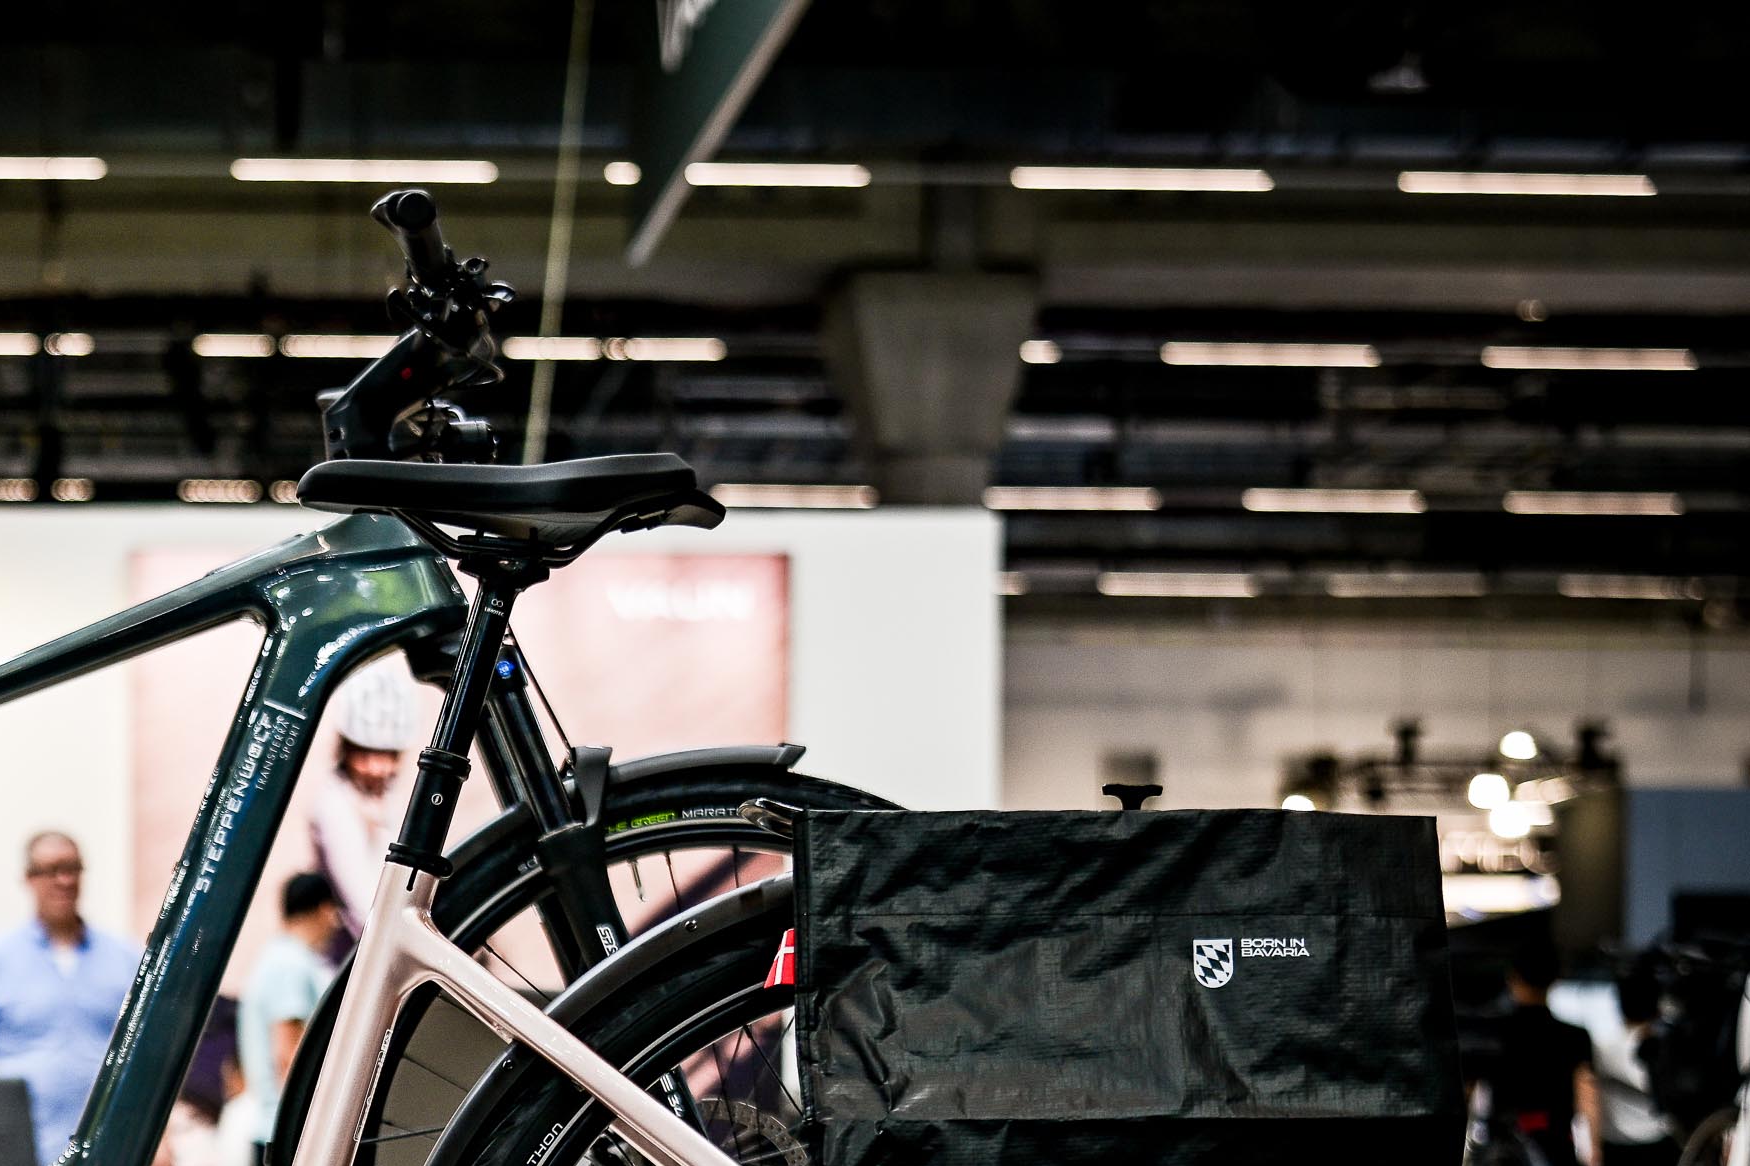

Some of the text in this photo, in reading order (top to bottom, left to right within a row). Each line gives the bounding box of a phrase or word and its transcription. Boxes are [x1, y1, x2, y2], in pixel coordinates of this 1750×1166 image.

[279, 723, 301, 761] SPORT
[196, 711, 273, 893] STEPPENWOLF
[630, 811, 676, 828] GREEN
[681, 806, 740, 820] MARAT
[1240, 938, 1306, 948] BORN IN
[1241, 947, 1311, 957] BAVARIA
